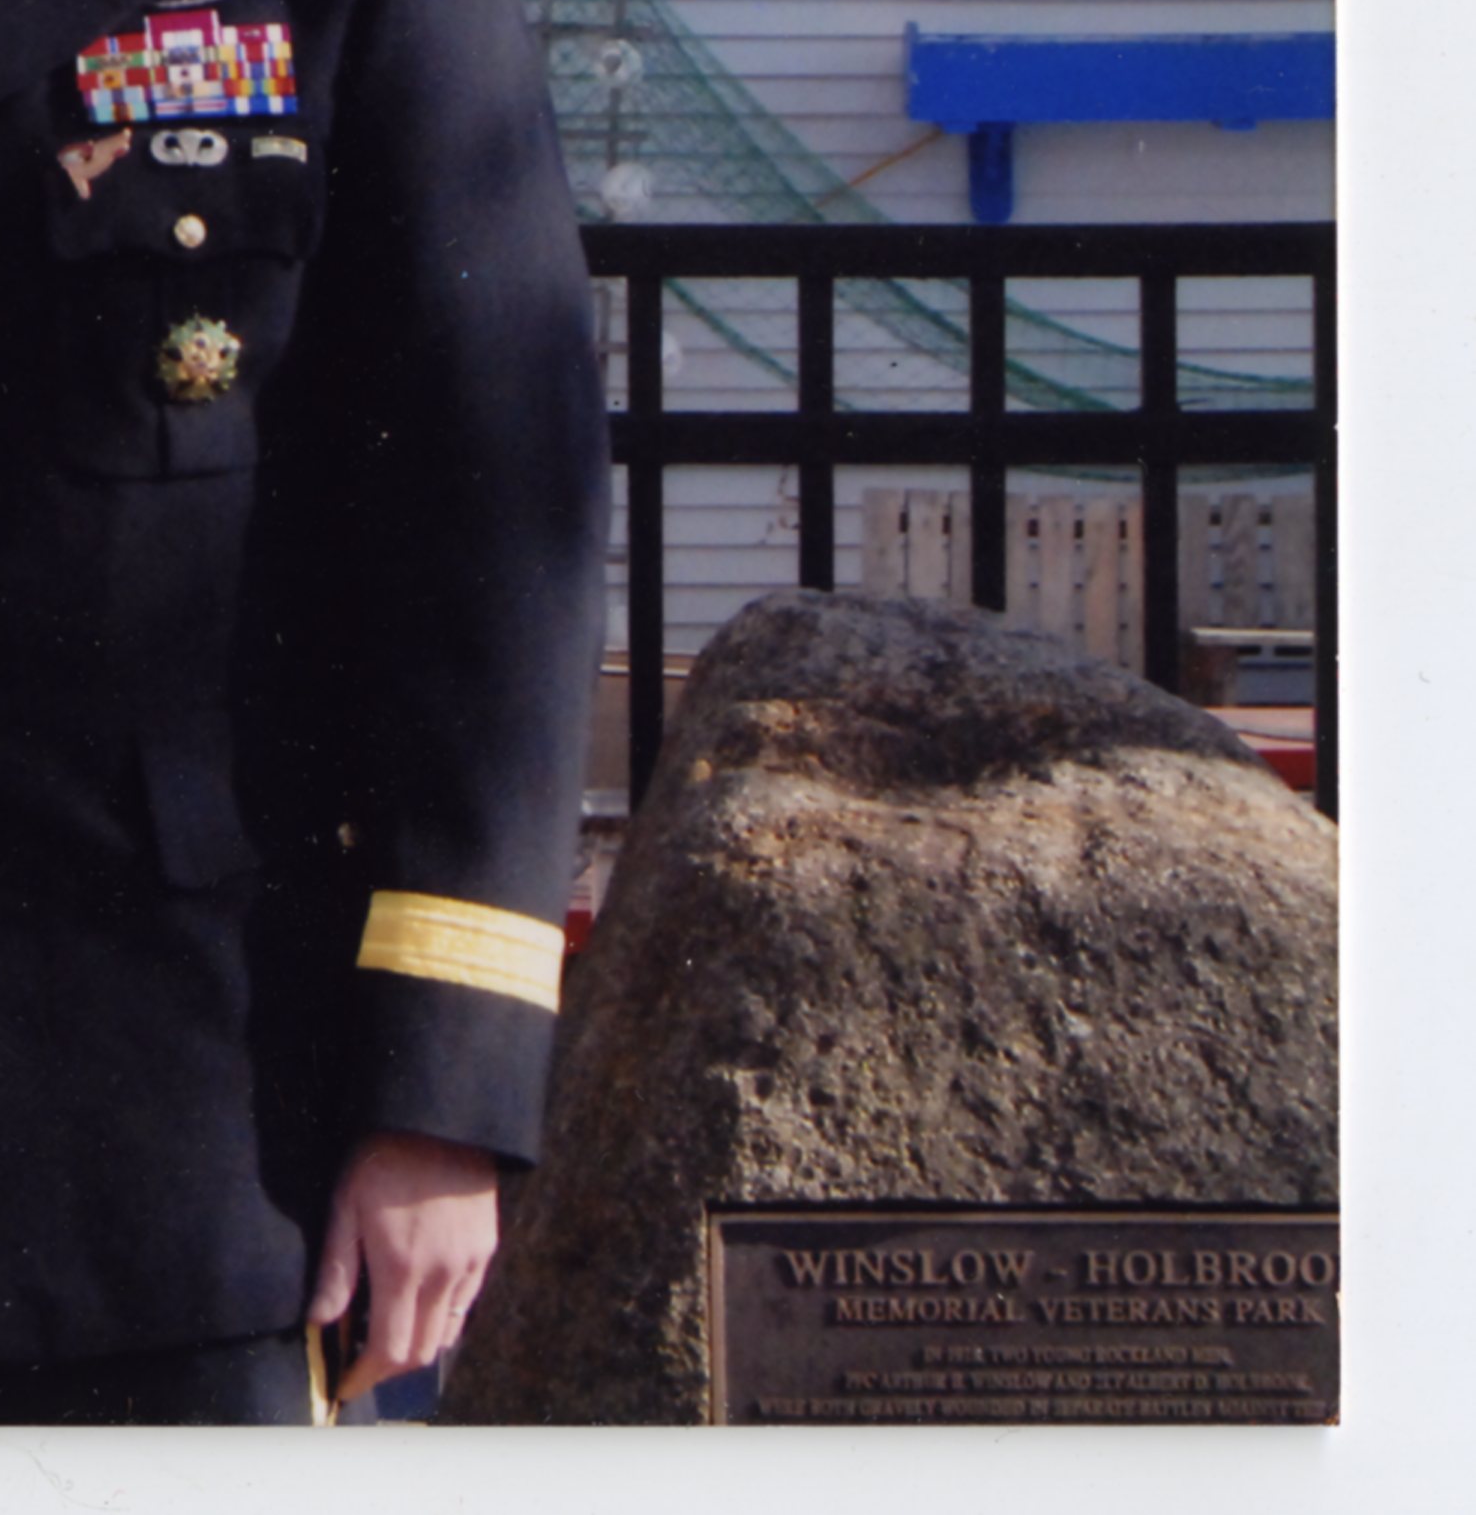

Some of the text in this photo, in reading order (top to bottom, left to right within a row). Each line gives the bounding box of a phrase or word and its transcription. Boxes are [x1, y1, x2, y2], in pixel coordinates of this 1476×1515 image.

[783, 1248, 1035, 1287] WINSLOW
[1084, 1248, 1339, 1287] HOLBROO
[834, 1295, 1325, 1325] MEMORIAL VETERANS PARK
[1096, 1344, 1187, 1365] ROCKLAND
[970, 1371, 1054, 1391] WINSLOW
[1056, 1371, 1091, 1391] AND
